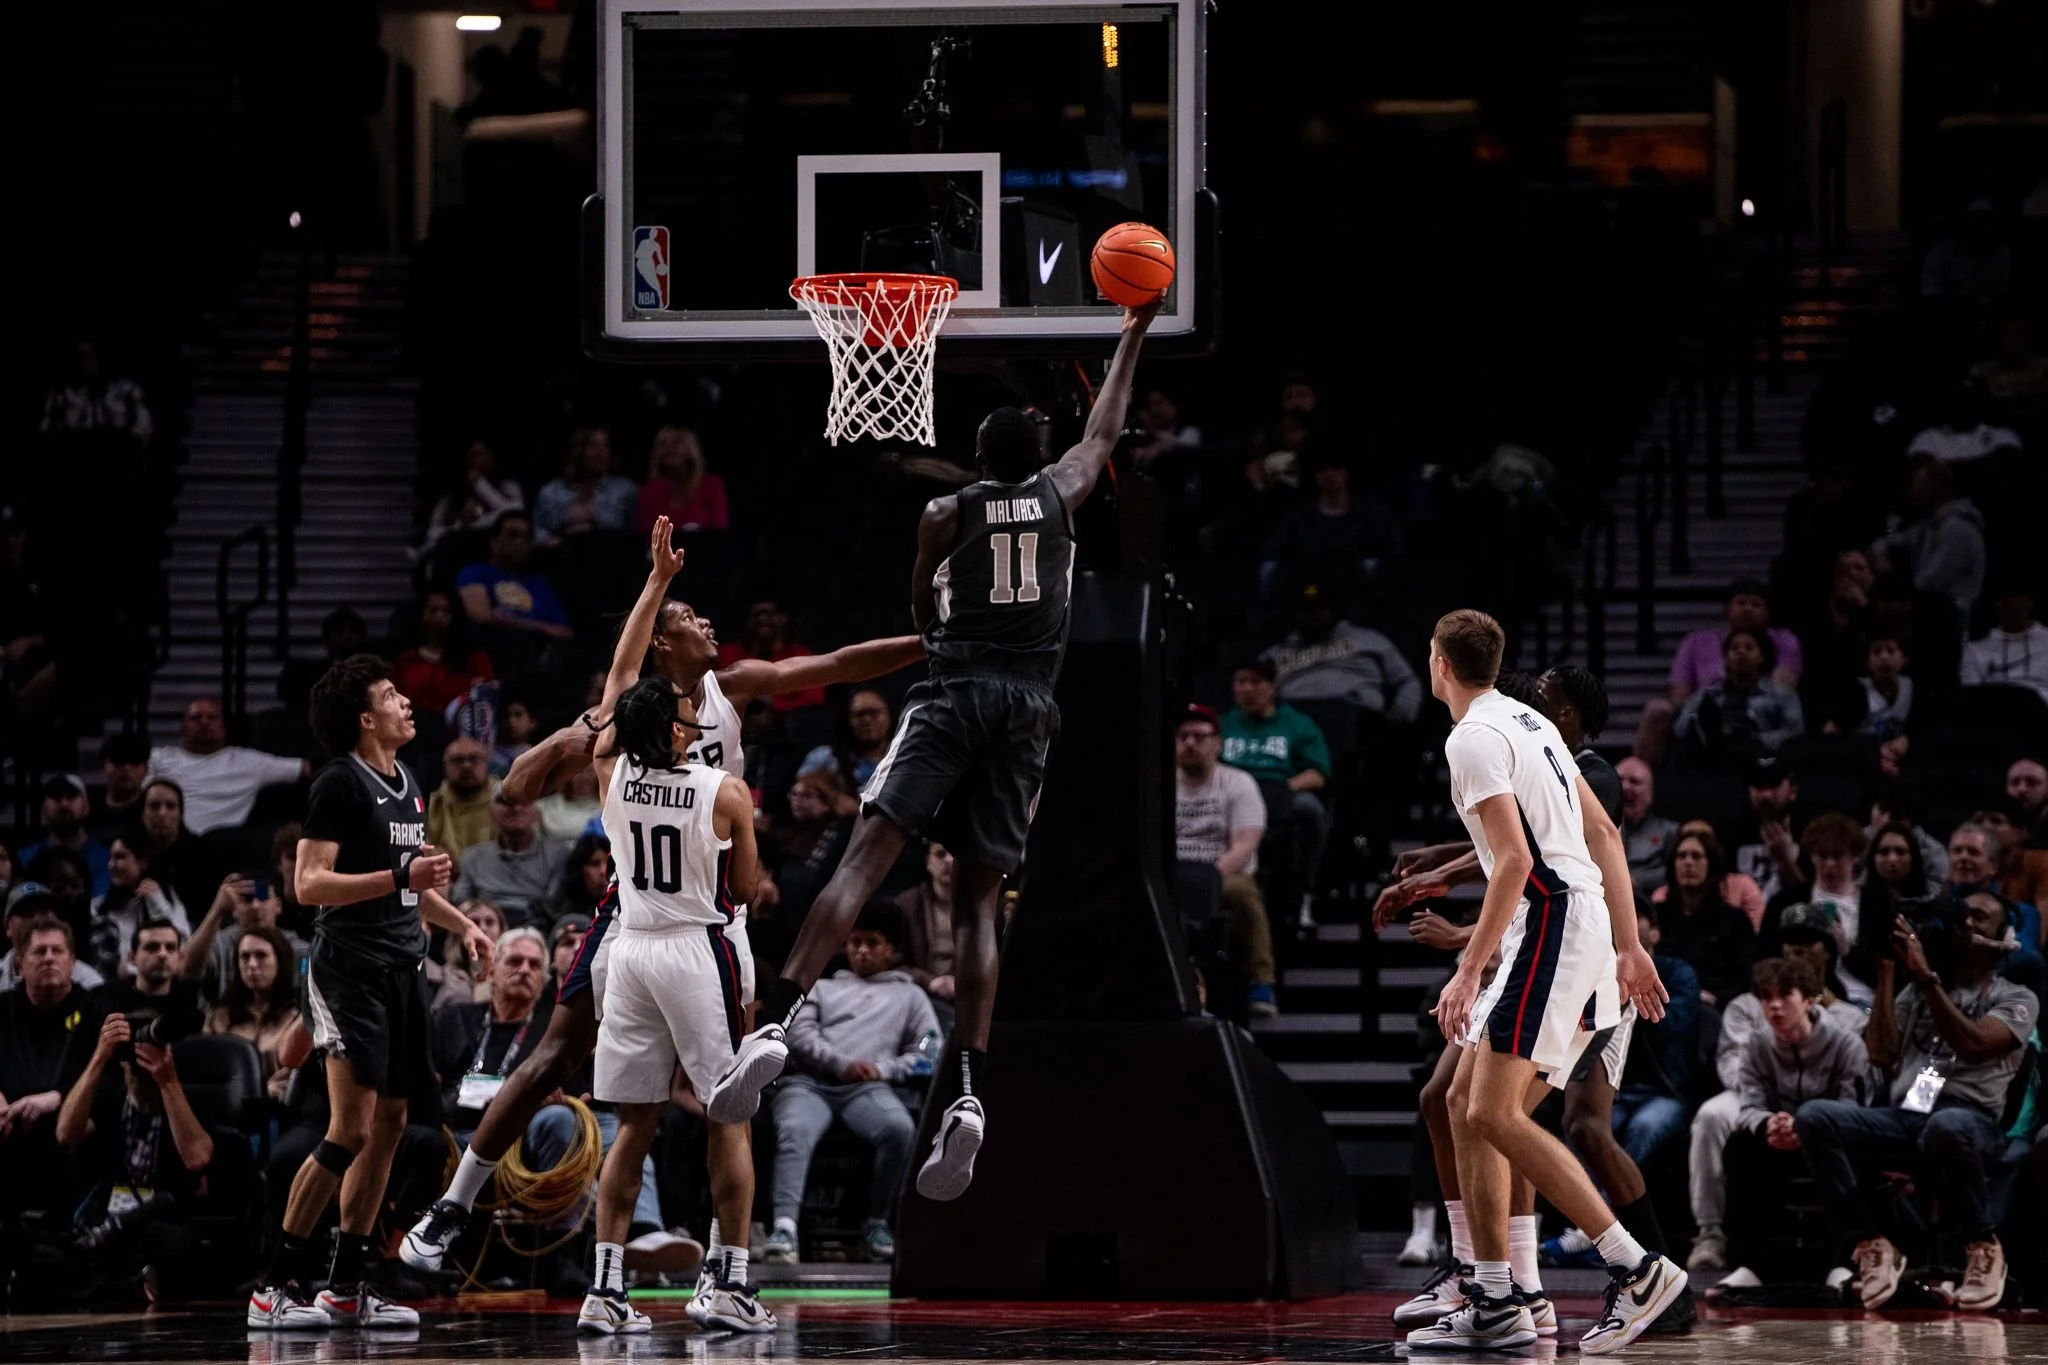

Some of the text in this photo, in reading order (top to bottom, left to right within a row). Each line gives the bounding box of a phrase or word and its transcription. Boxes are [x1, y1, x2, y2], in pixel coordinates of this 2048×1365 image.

[638, 291, 657, 305] NBA
[985, 498, 1044, 524] MALUACH
[990, 533, 1041, 604] 11
[1543, 745, 1574, 813] 9
[623, 780, 696, 809] CASTILLO
[389, 821, 425, 846] FRANCE
[629, 820, 682, 894] 10
